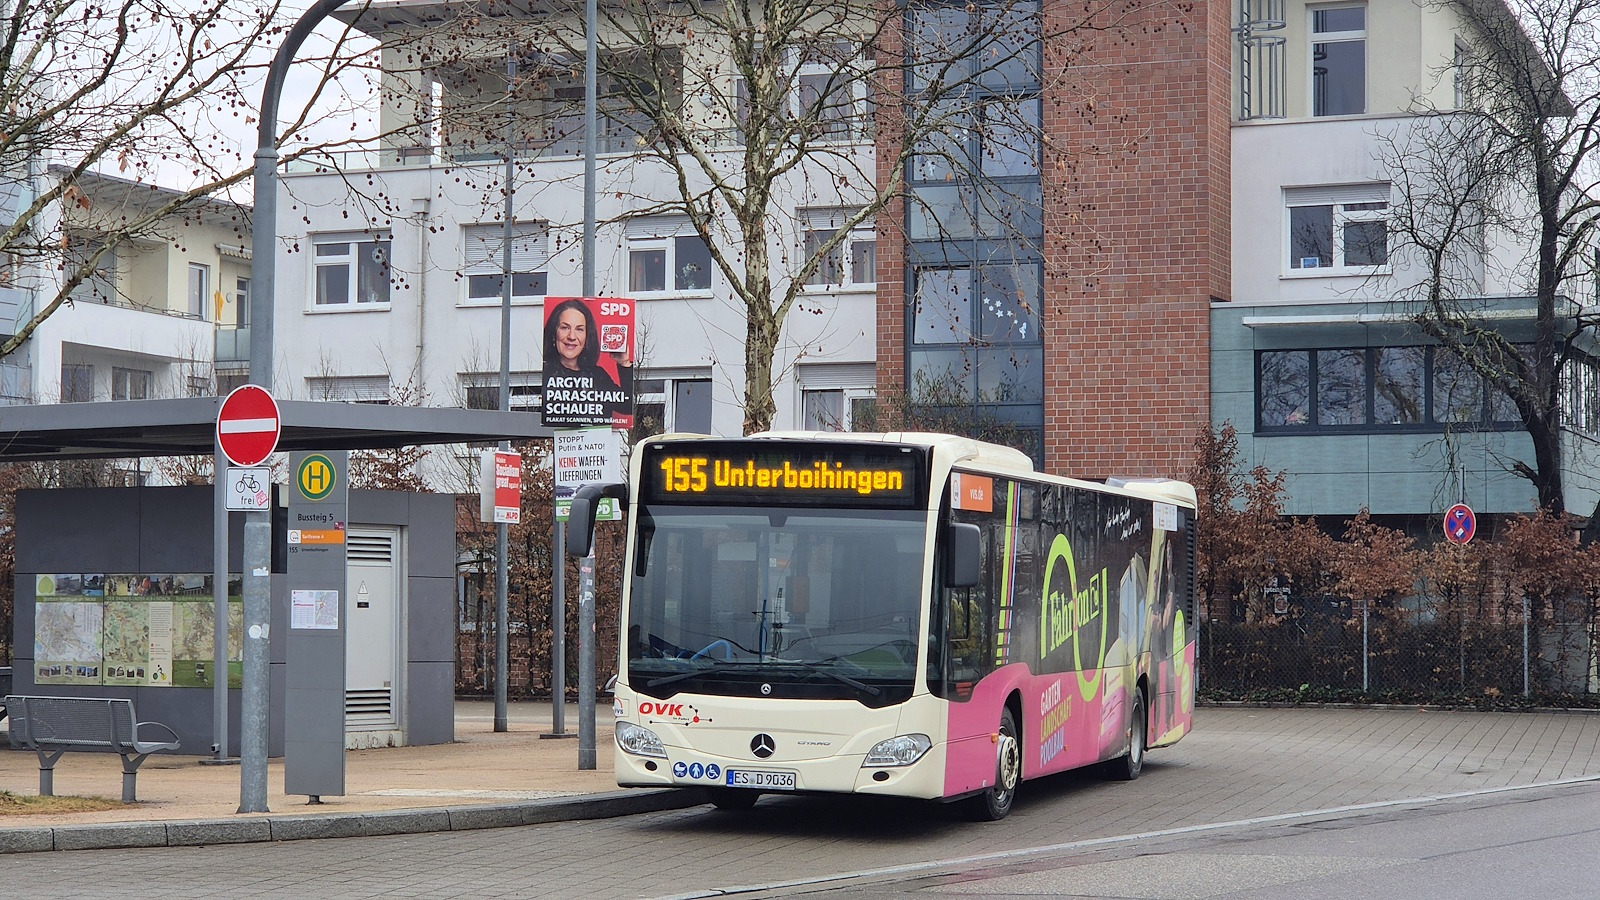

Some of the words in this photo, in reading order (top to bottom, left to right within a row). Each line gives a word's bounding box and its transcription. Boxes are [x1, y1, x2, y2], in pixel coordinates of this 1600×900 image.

[600, 302, 630, 316] SPD
[605, 334, 623, 342] SPD
[546, 376, 593, 388] ARGYRI
[546, 390, 630, 403] PARASCHAKI-
[546, 403, 604, 415] SCHAUER
[604, 416, 628, 424] WÄHLEN!
[558, 435, 585, 444] STOPPT
[558, 444, 576, 452] Putin
[577, 443, 583, 451] &
[584, 443, 606, 451] NATO!
[558, 456, 577, 468] KEINE
[578, 455, 608, 467] WAFFEN-
[308, 464, 324, 490] H
[559, 469, 602, 482] LIEFERUNGEN
[661, 457, 708, 492] 155
[714, 459, 902, 494] Unterboihingen
[969, 485, 984, 501] vvs.de
[241, 495, 255, 505] frei
[297, 512, 327, 523] Bussteig
[329, 513, 334, 521] 5
[289, 546, 299, 554] 155
[1050, 583, 1090, 651] Fahrion
[1041, 678, 1061, 716] GARTEN
[639, 702, 684, 716] OVK
[1041, 694, 1072, 743] LANDSCHAFT
[1040, 725, 1065, 769] POOLBAU
[734, 772, 749, 784] ES
[756, 773, 764, 785] D
[766, 774, 793, 786] 9036
